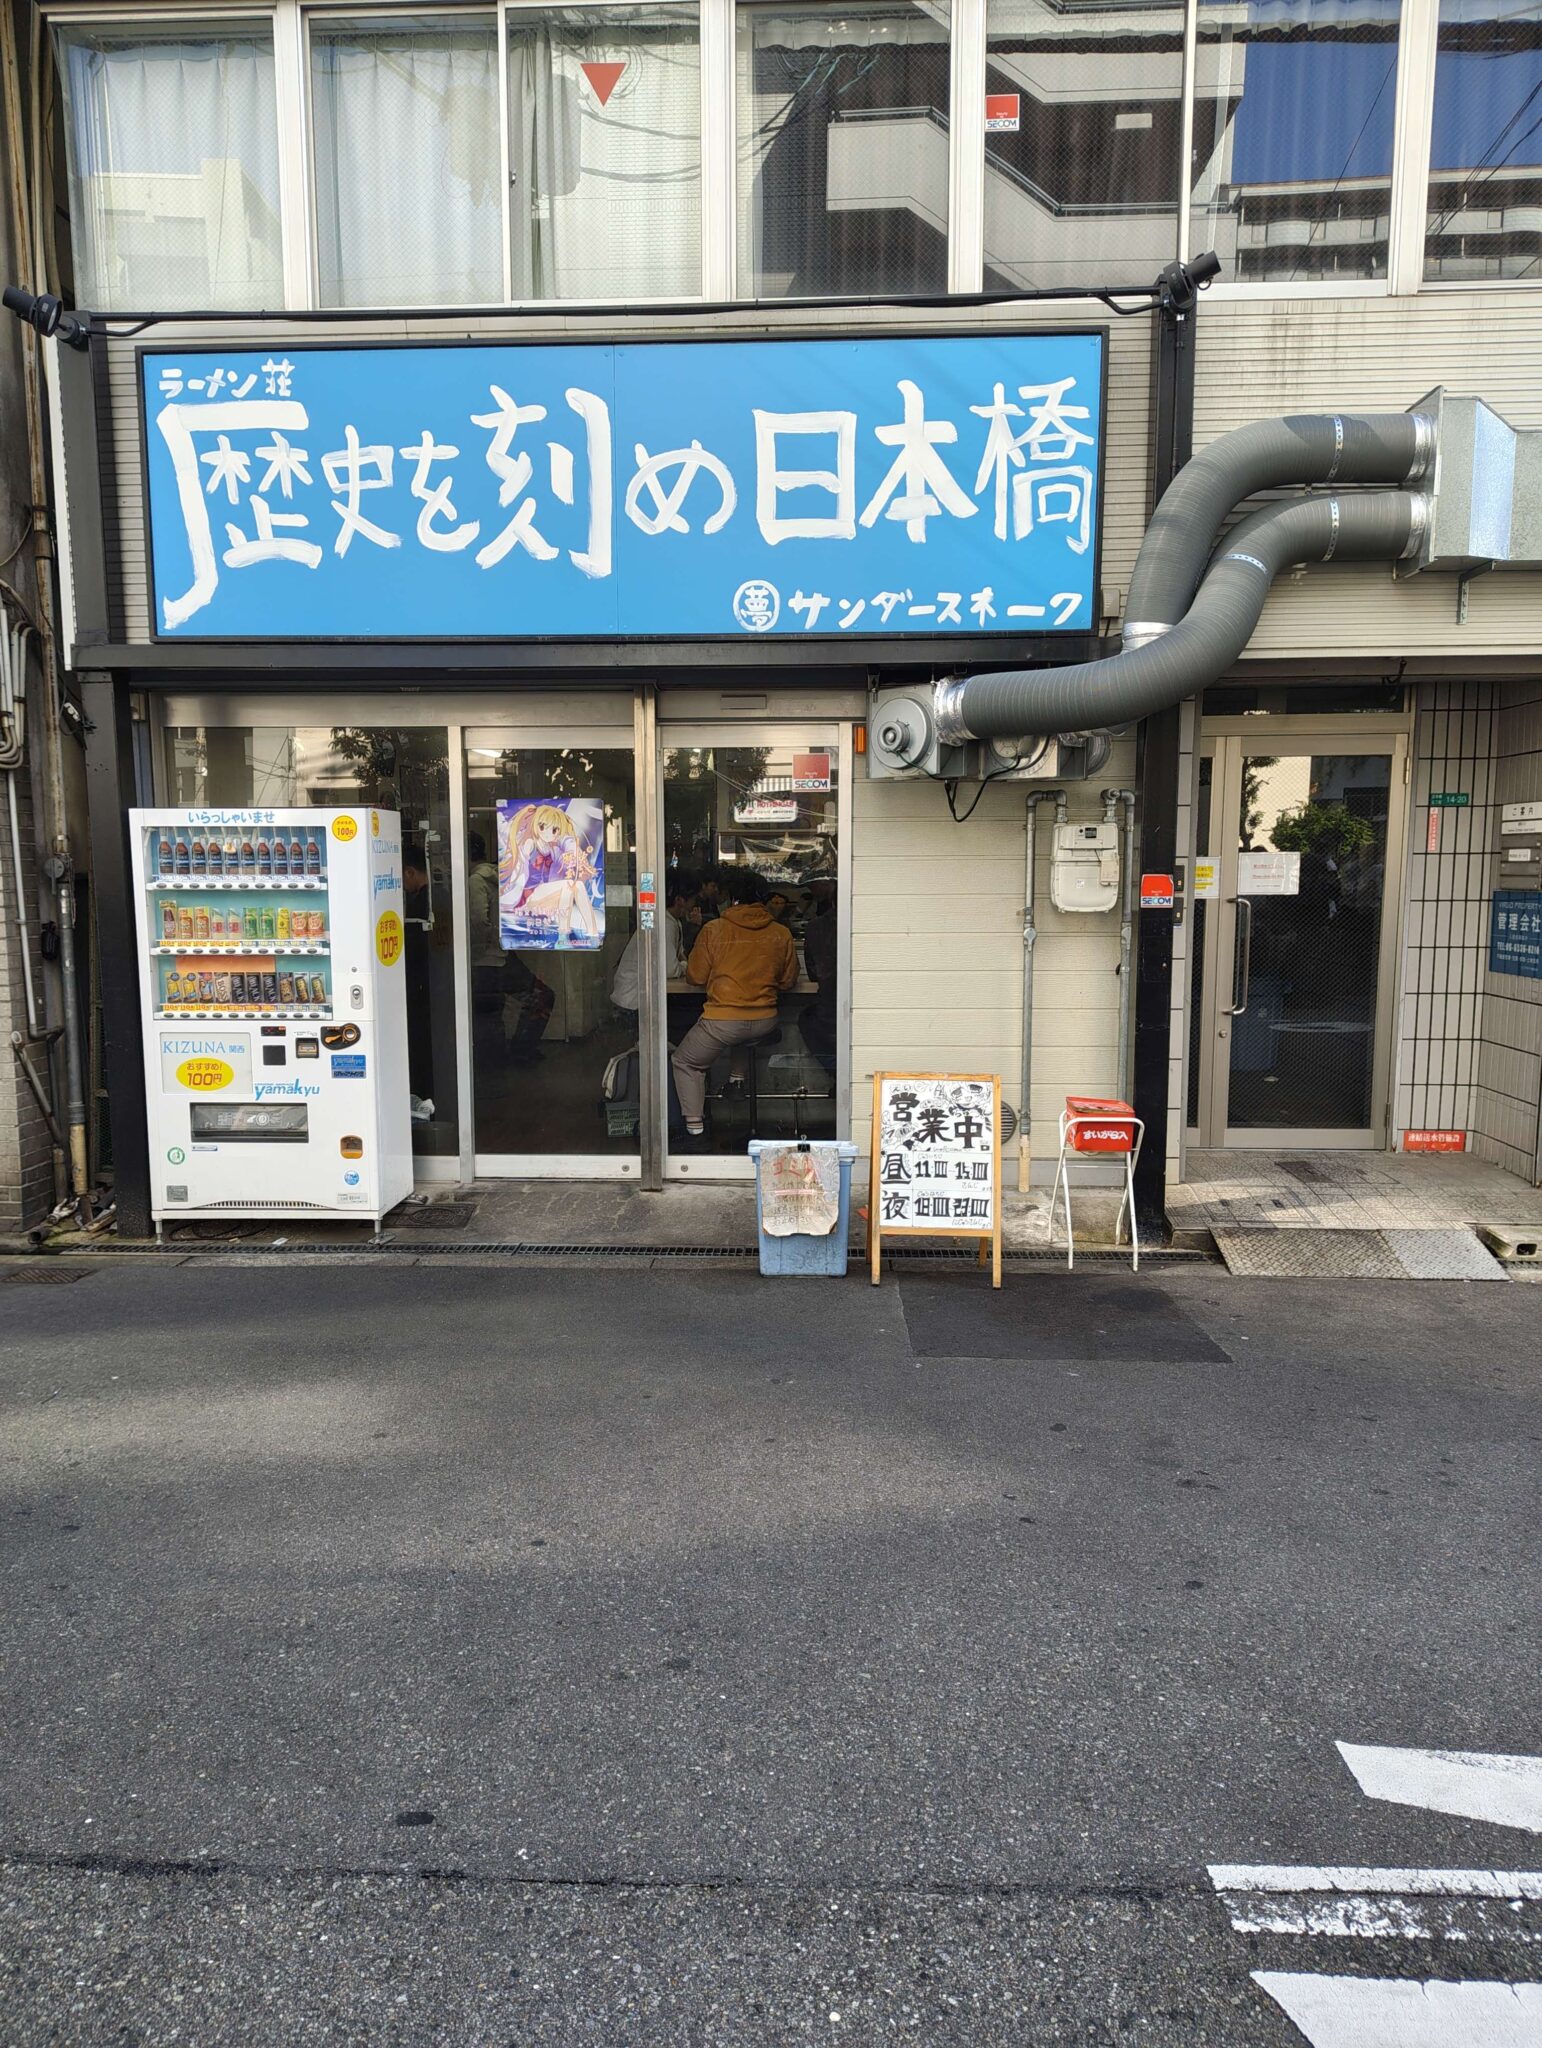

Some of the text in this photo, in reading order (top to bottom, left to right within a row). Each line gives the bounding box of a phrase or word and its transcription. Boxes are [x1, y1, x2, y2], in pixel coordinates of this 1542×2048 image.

[987, 120, 1017, 128] SECOM
[159, 358, 295, 398] ラーメン荘
[787, 586, 1083, 629] サンダースネーク
[795, 779, 828, 788] SECOM
[1446, 795, 1467, 804] 14-20
[188, 811, 275, 824] いらっしゃいませ
[373, 867, 402, 900] yamakyu
[1142, 896, 1172, 905] SECOM
[1497, 912, 1541, 933] 管理会社
[379, 936, 399, 961] 100円
[163, 1041, 245, 1054] KIZUNA 関西
[187, 1073, 222, 1086] 100円
[254, 1078, 321, 1101] yamakyu
[1083, 1130, 1129, 1141] すいがら入
[881, 1152, 912, 1185] 昼
[881, 1190, 912, 1220] 夜
